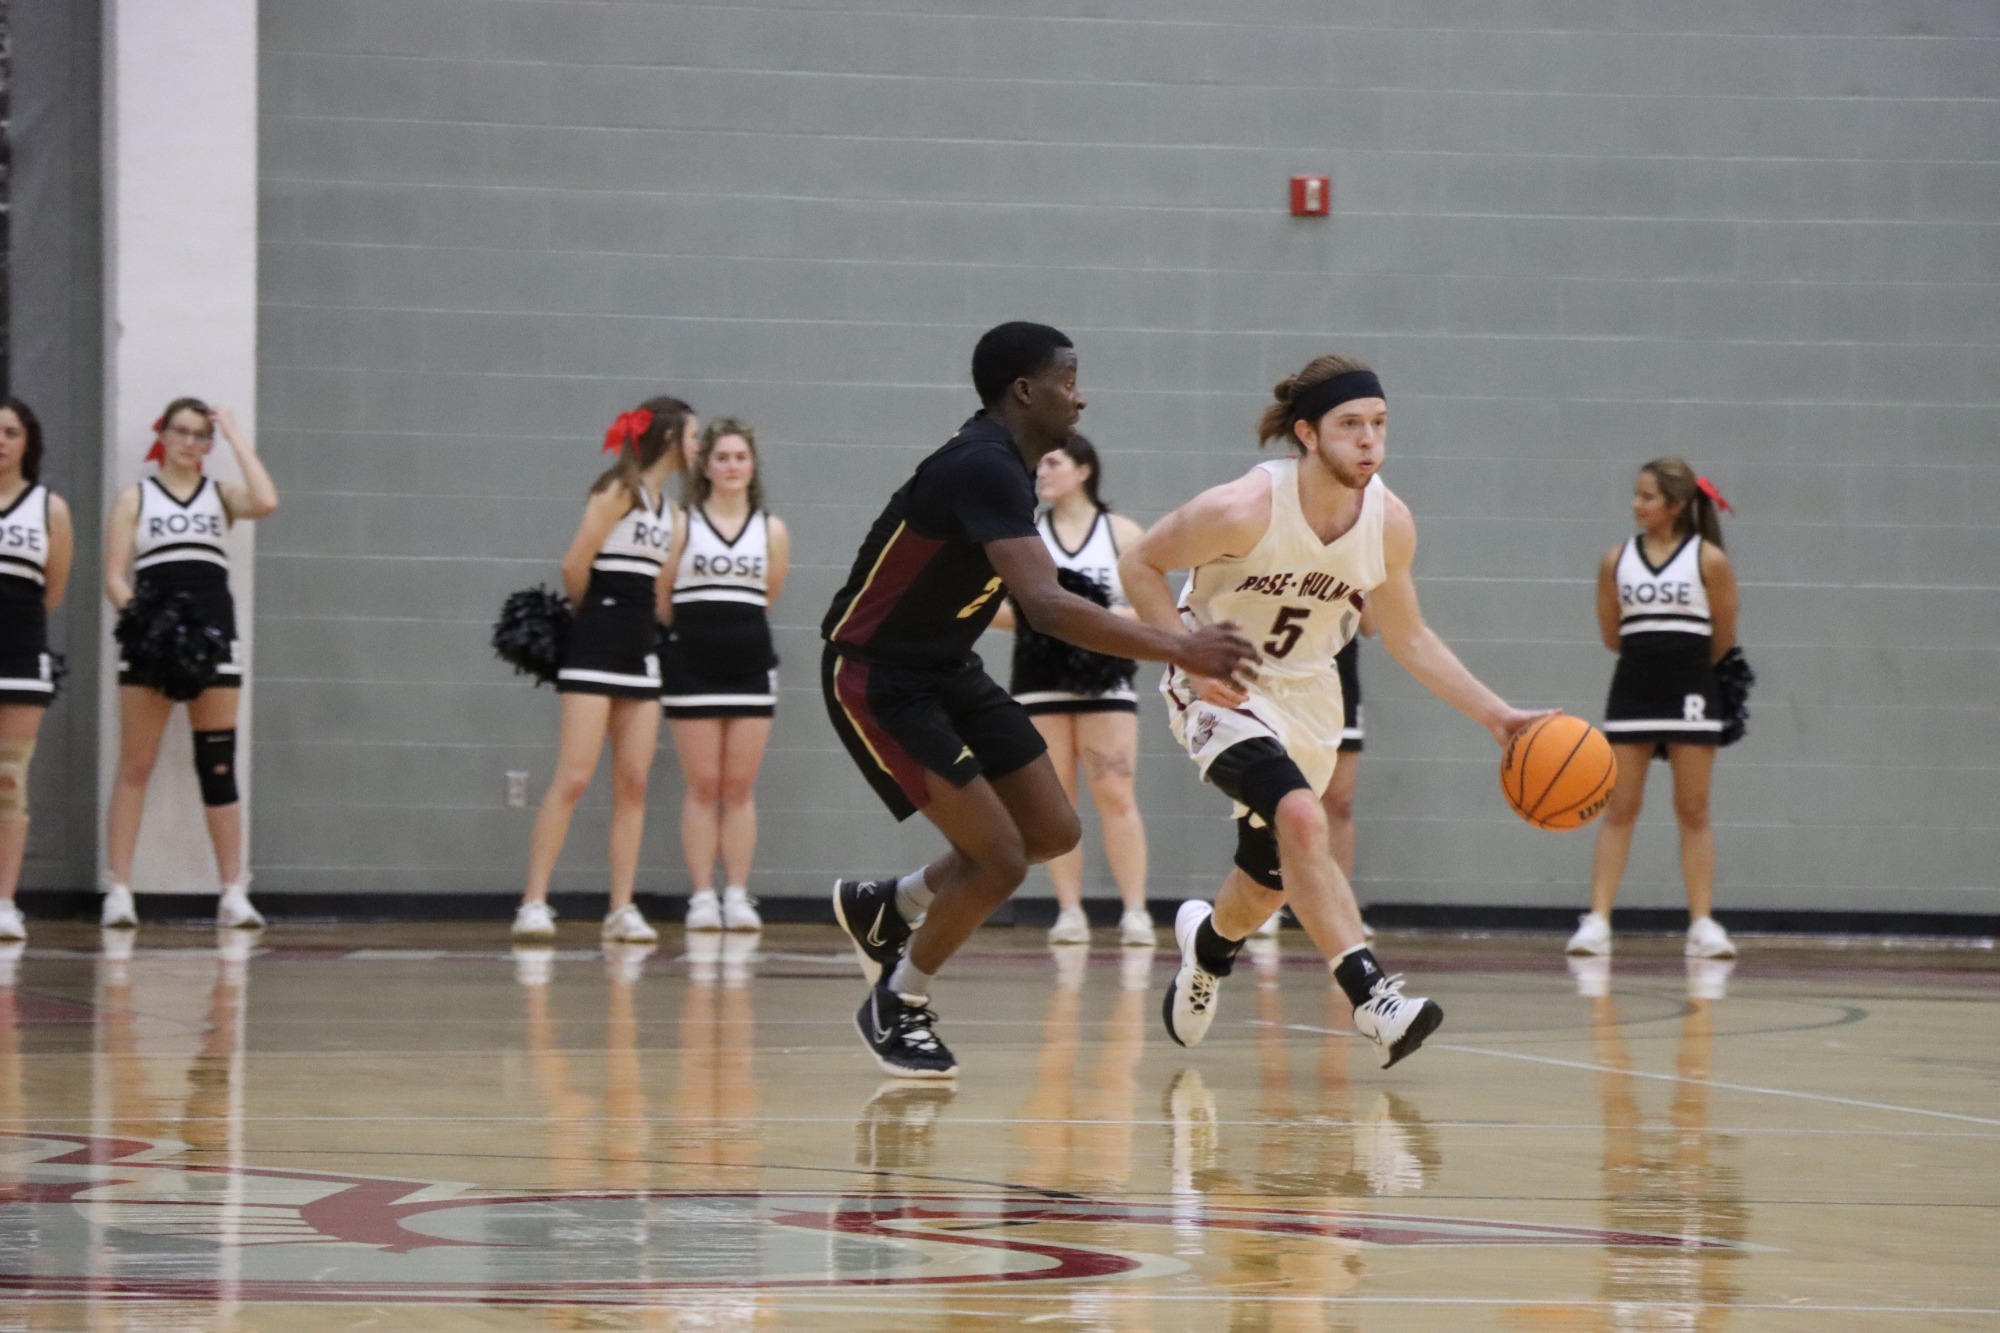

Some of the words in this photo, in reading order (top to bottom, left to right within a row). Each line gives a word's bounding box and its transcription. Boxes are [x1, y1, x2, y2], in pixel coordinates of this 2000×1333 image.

[0, 525, 41, 552] SE
[149, 513, 222, 539] ROSE
[692, 554, 763, 578] ROSE
[955, 576, 1002, 618] 2
[1621, 582, 1691, 606] ROSE
[1263, 605, 1312, 659] 5
[1683, 693, 1706, 721] R
